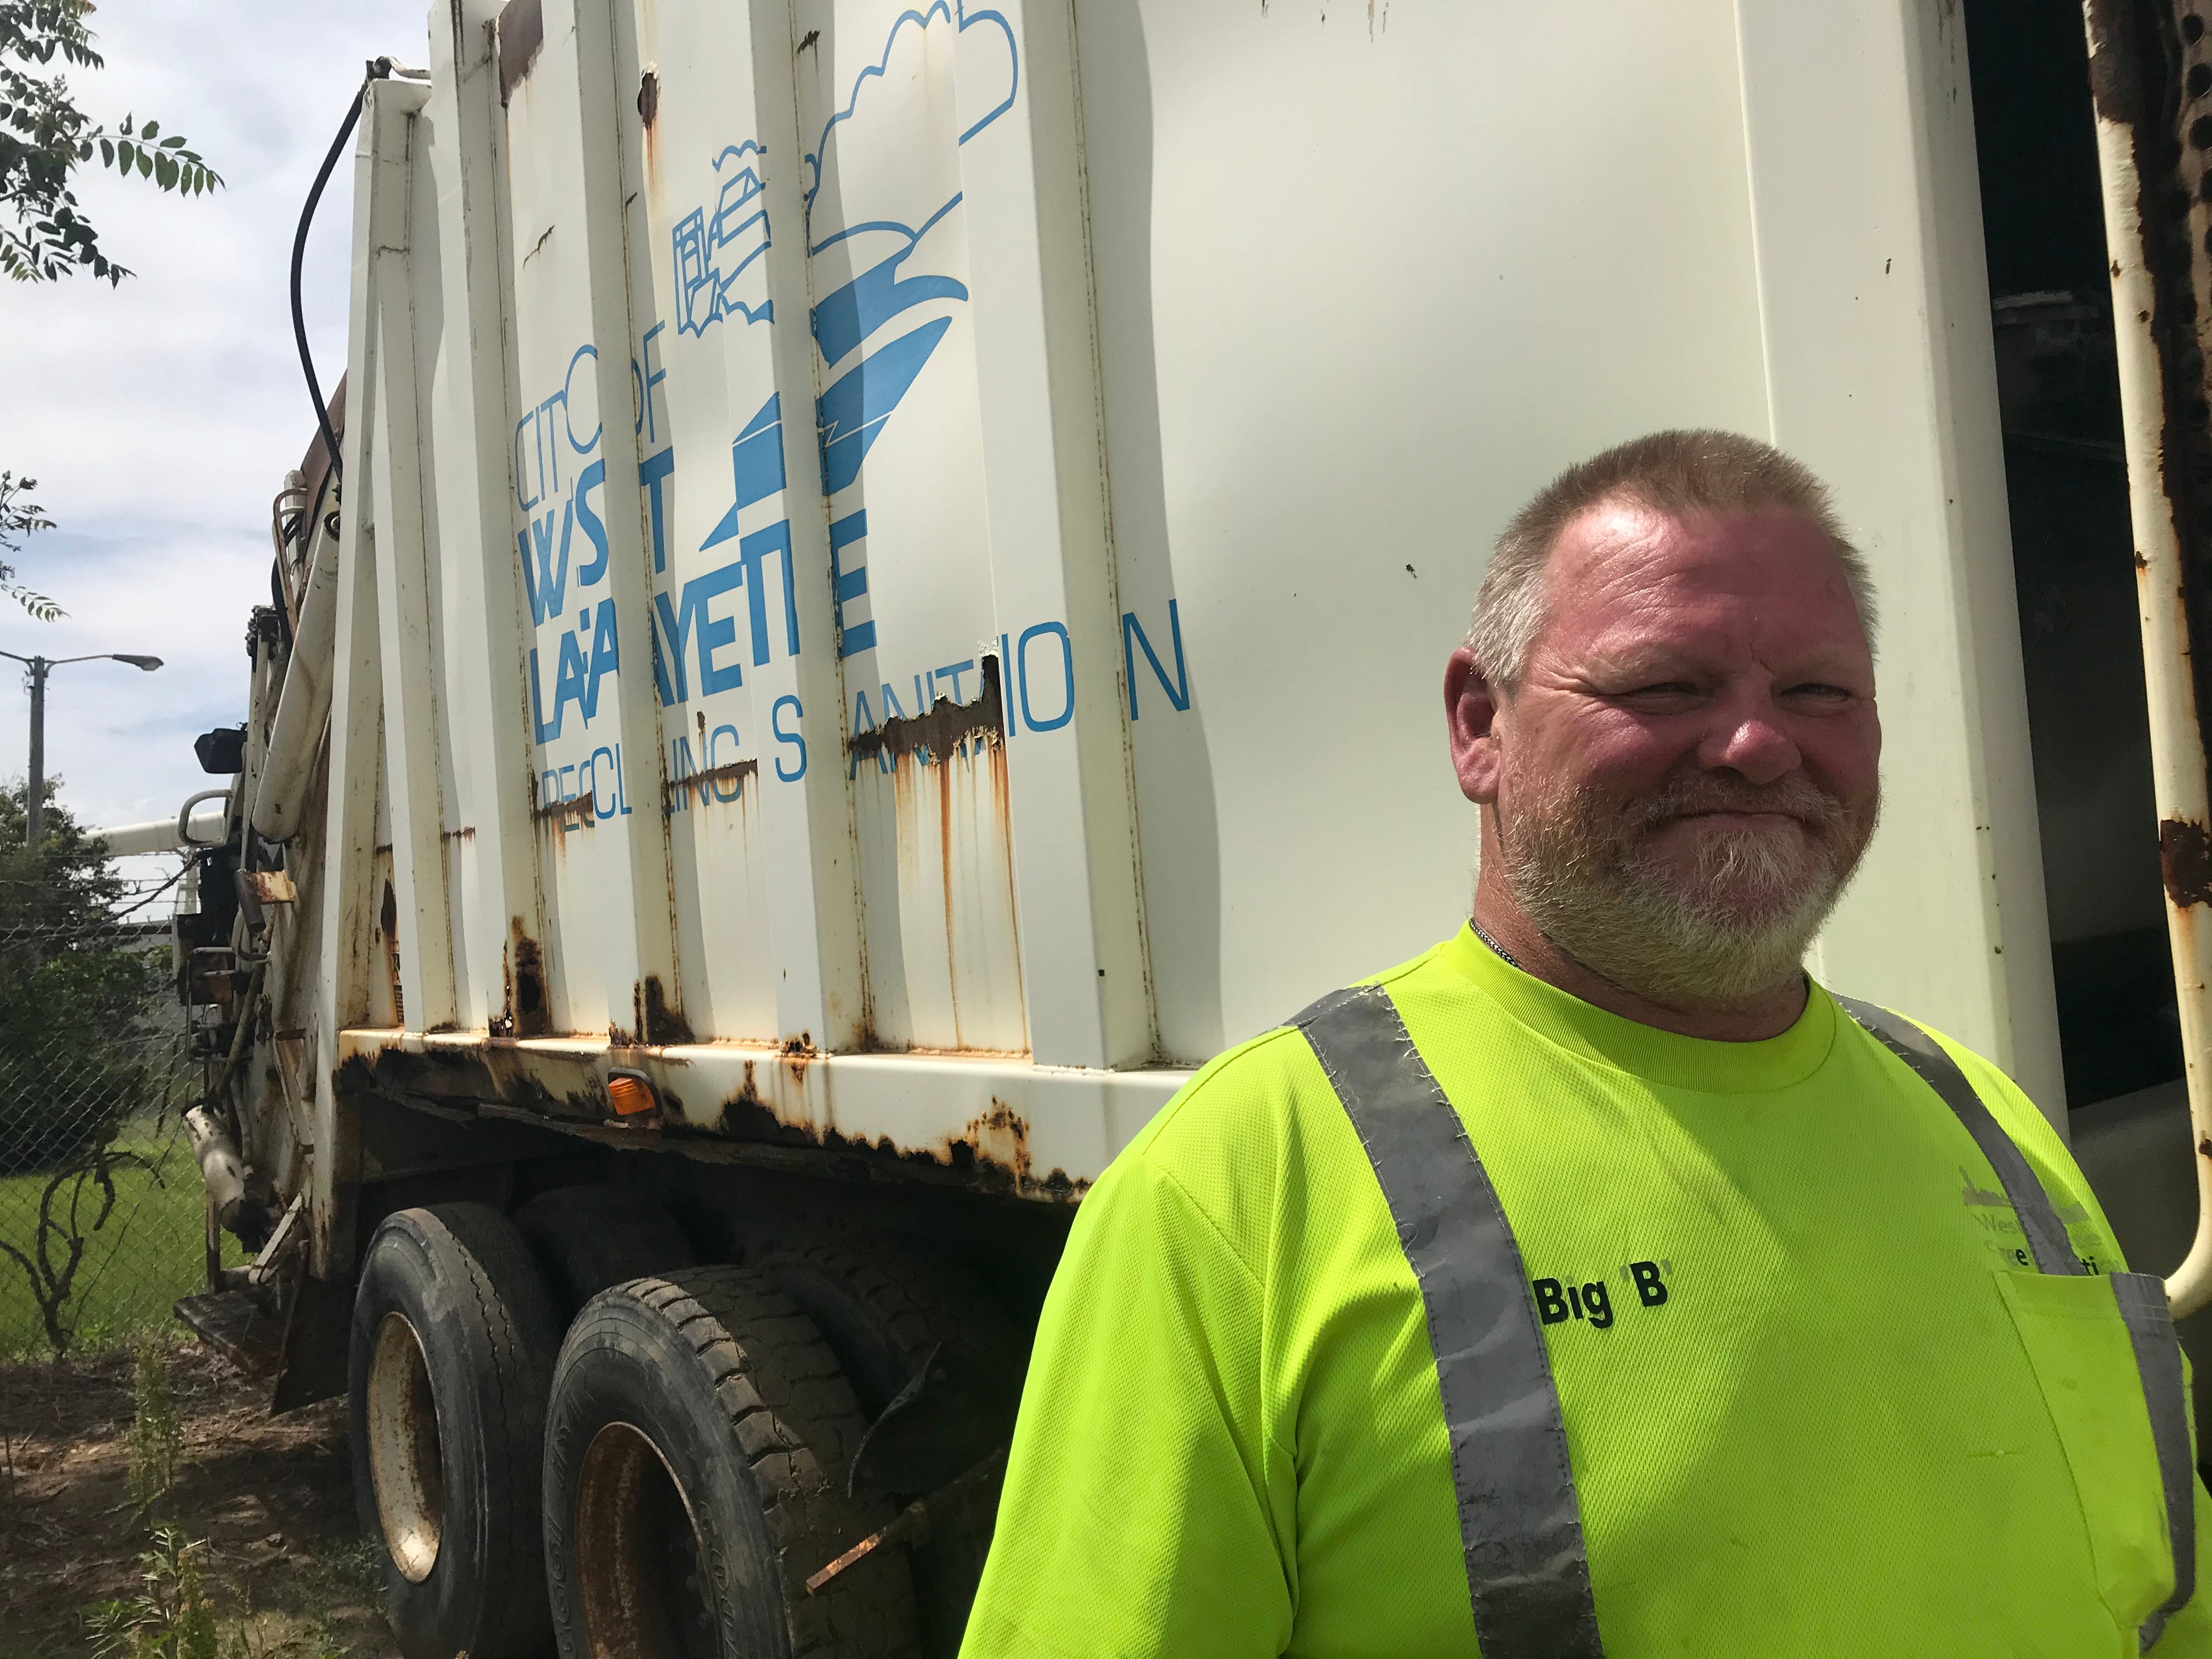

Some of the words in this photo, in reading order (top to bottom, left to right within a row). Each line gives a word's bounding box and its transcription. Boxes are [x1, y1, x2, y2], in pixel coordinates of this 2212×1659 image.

[517, 447, 674, 627] WST
[529, 508, 878, 746] LAAYETTE
[1532, 1275, 1613, 1329] Big
